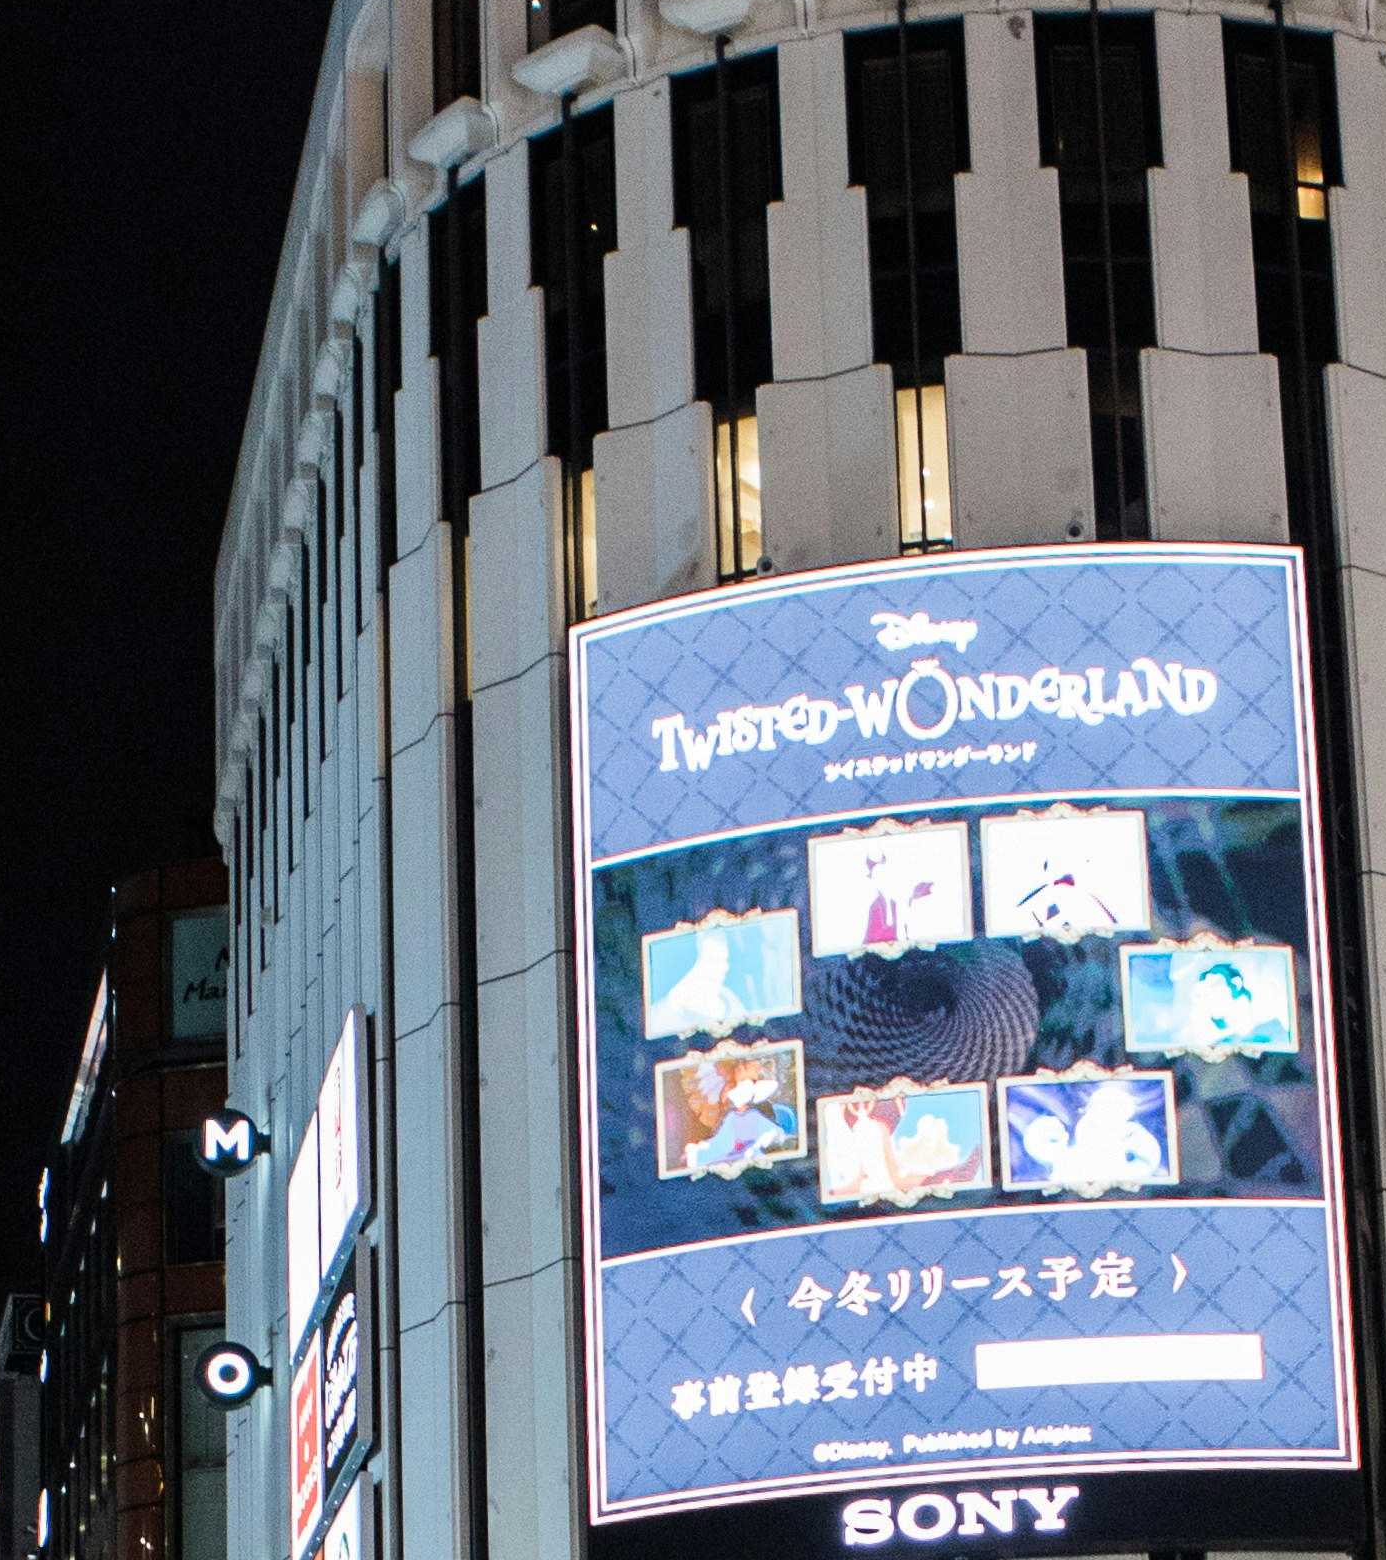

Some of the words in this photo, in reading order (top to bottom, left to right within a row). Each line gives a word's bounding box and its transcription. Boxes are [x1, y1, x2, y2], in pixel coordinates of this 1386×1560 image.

[870, 612, 978, 652] Disney
[670, 1351, 940, 1421] 事前登録受付中
[903, 1429, 992, 1454] Published
[996, 1428, 1019, 1450] by
[1022, 1425, 1092, 1446] Aniplex
[842, 1486, 1080, 1547] SONY
